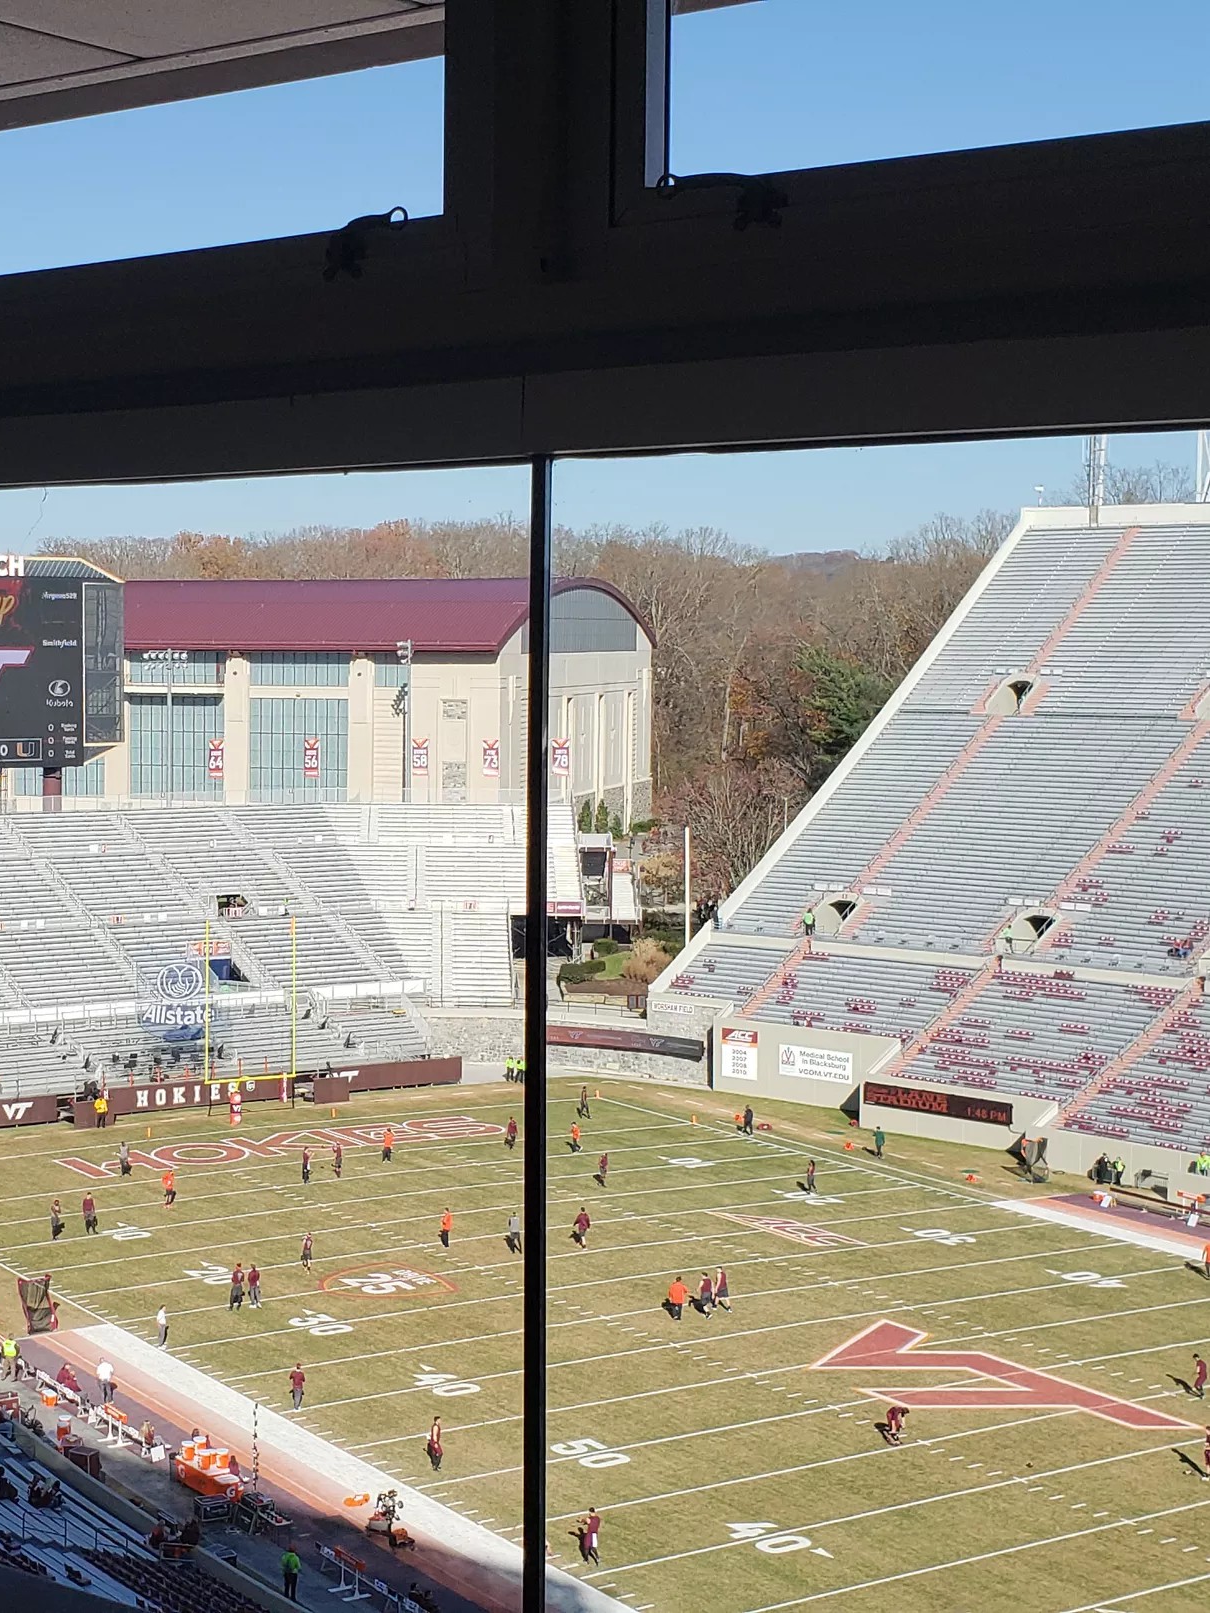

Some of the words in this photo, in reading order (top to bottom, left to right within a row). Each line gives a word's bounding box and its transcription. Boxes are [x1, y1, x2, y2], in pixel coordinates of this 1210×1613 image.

[42, 639, 77, 648] Smithfield
[46, 699, 74, 708] Kubota
[0, 744, 8, 756] 0
[209, 756, 223, 769] 64
[305, 755, 318, 768] 56
[413, 755, 427, 767] 58
[483, 755, 498, 768] 73
[554, 755, 569, 767] 78
[143, 1005, 215, 1025] Allstate
[678, 1005, 693, 1014] FIELD
[725, 1030, 754, 1042] ACC
[799, 1050, 825, 1060] Medical
[826, 1054, 850, 1063] School
[810, 1059, 847, 1071] Blacksburg
[798, 1068, 850, 1081] VCOM.VT.EDU
[897, 1088, 947, 1104] LANE
[867, 1093, 948, 1113] STADIUM
[2, 1102, 33, 1120] VT
[990, 1111, 1007, 1122] PM
[52, 1115, 507, 1179] HOKIES
[339, 1273, 417, 1295] 25
[288, 1313, 353, 1336] 30
[413, 1373, 482, 1397] 40
[550, 1438, 632, 1469] 50
[725, 1522, 812, 1554] 40
